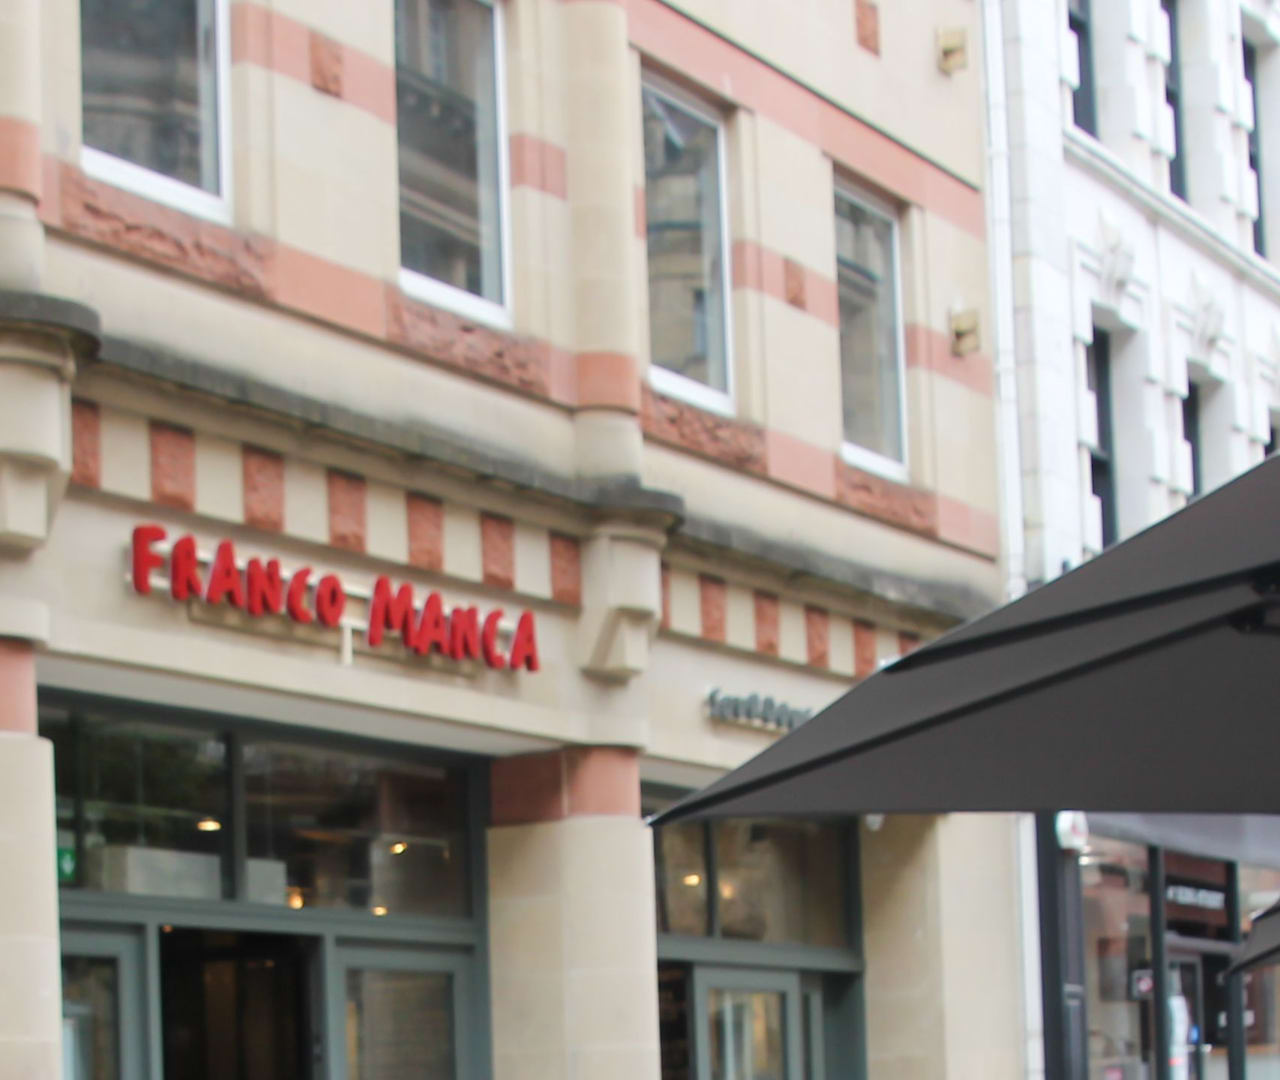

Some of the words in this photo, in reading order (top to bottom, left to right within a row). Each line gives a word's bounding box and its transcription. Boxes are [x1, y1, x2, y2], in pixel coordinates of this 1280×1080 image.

[132, 524, 346, 628] FRANCO
[368, 575, 540, 672] MANCA
[708, 686, 812, 731] SOURDOU
